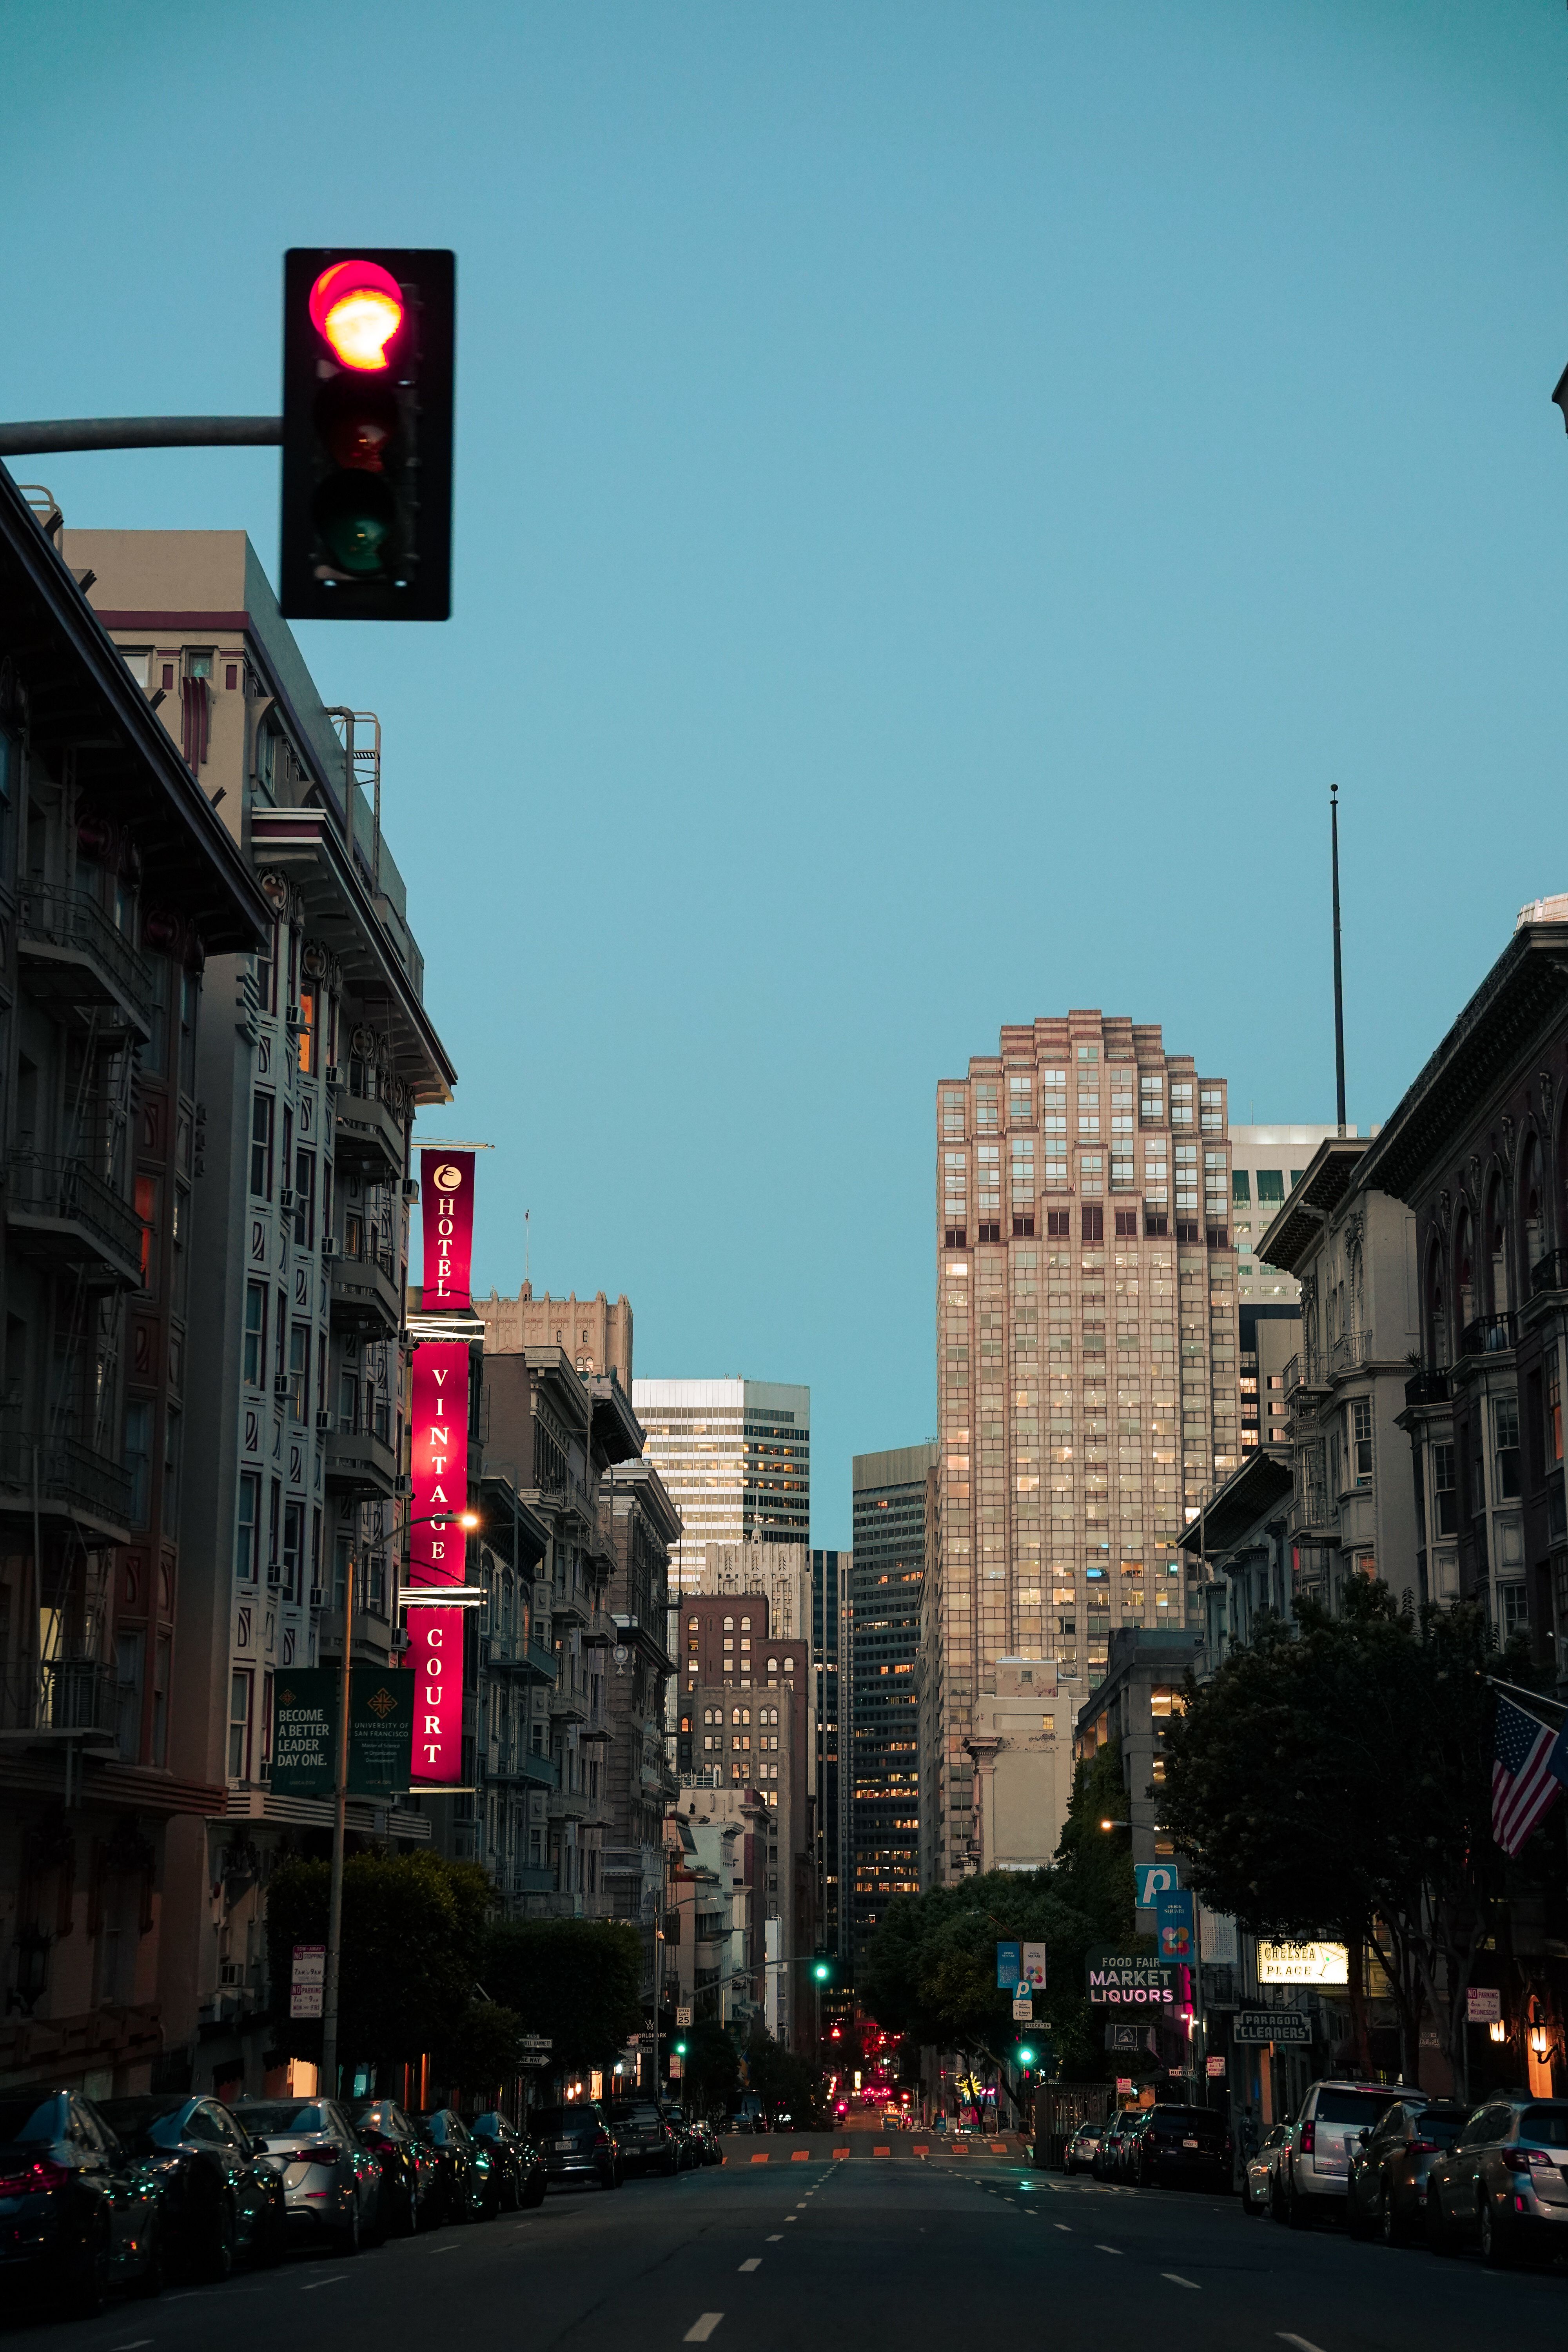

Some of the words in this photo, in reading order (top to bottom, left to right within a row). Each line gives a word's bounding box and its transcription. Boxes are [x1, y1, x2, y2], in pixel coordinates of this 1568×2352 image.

[437, 1198, 455, 1297] HOTEL
[430, 1369, 449, 1559] VINTAGE
[423, 1629, 443, 1763] COURT
[279, 1709, 323, 1722] BECOME
[278, 1725, 286, 1737] A
[289, 1724, 329, 1737] BETTER
[278, 1739, 319, 1751] LEADER
[277, 1754, 299, 1766] DAY
[301, 1754, 327, 1766] ONE.
[1265, 1948, 1316, 1959] CHELSEA
[1102, 1957, 1132, 1967] FOOD
[1137, 1958, 1161, 1967] FAIR
[1267, 1966, 1310, 1975] PLACE
[1090, 1970, 1171, 1986] MARKET
[292, 1985, 301, 1994] NO
[1468, 1989, 1477, 1998] NO
[1091, 1989, 1174, 2004] LIQUORS
[1246, 2016, 1298, 2025] PARAGON
[1241, 2027, 1305, 2038] CLEANERS
